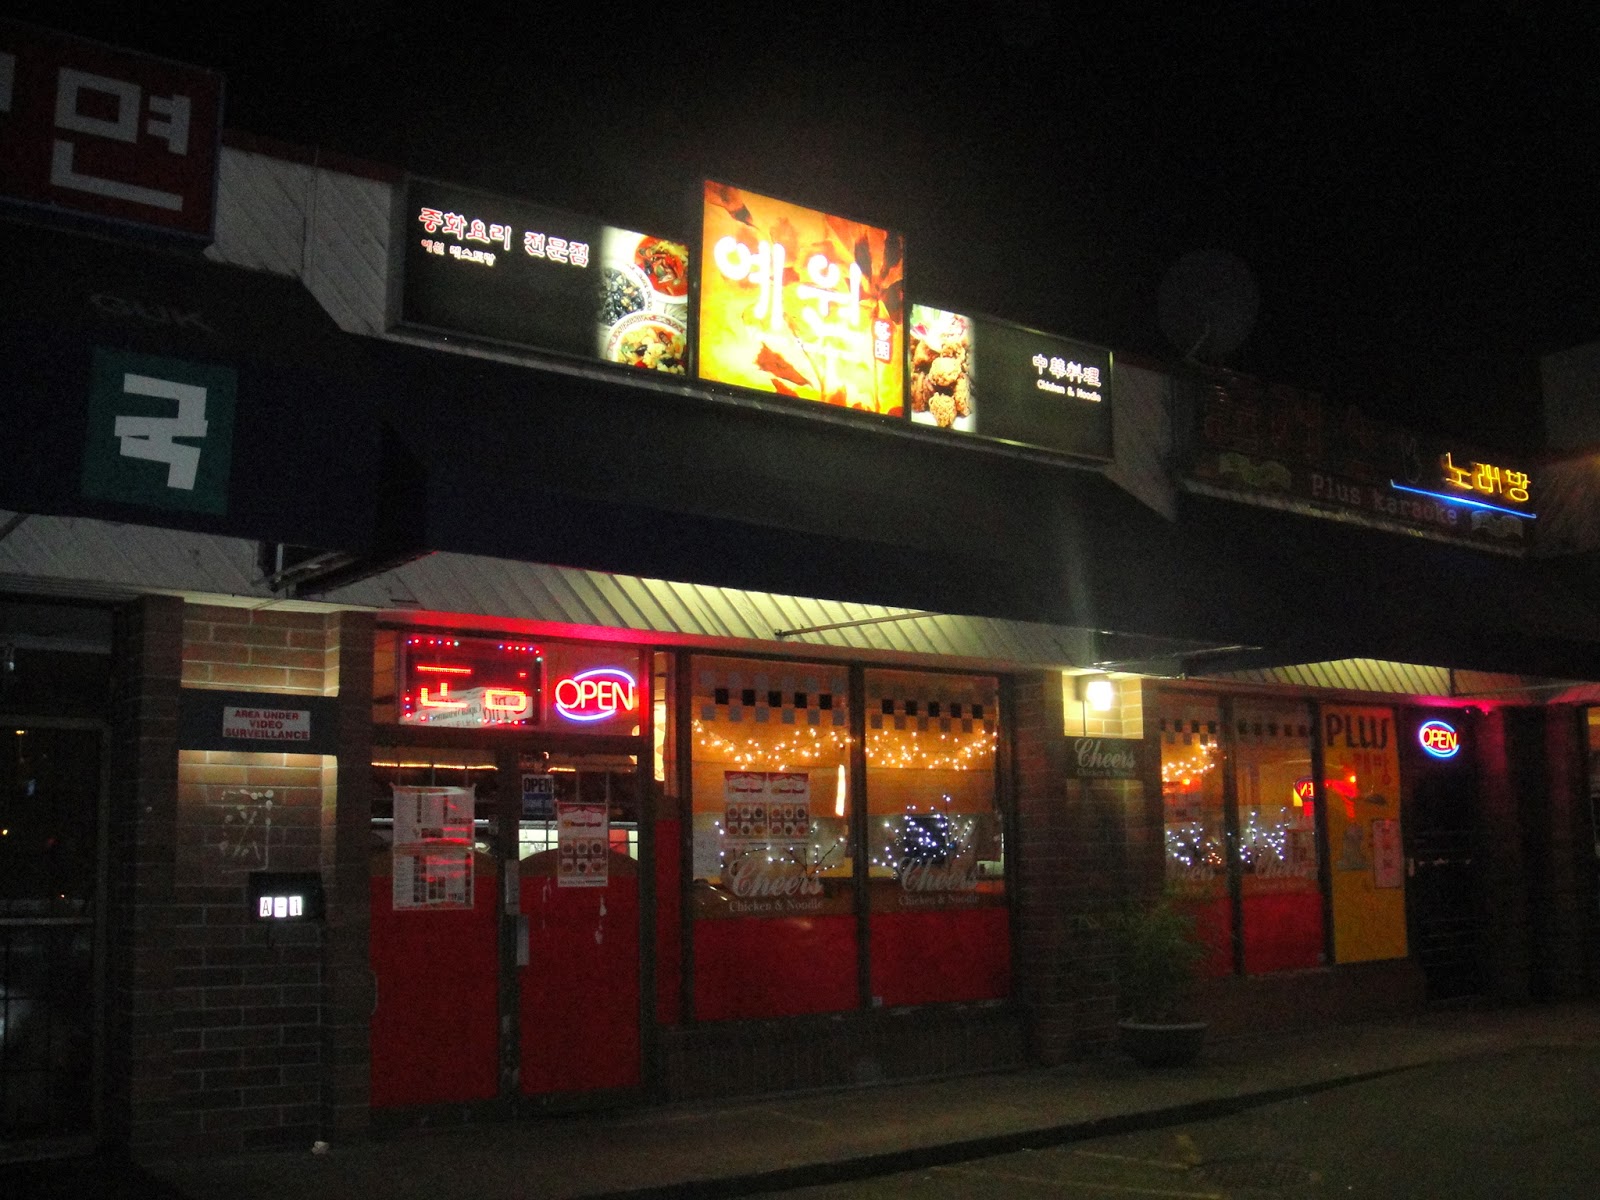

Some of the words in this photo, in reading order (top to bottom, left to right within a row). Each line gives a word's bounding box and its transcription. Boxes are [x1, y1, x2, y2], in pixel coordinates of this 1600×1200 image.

[419, 207, 512, 251] 중화요리
[523, 231, 589, 268] 전문점
[1032, 353, 1102, 388] 中華料理
[1442, 451, 1531, 503] 노래방
[555, 679, 634, 711] OPEN
[234, 709, 260, 719] AREA
[263, 711, 299, 721] UNDER
[249, 719, 283, 730] VIDEO
[225, 728, 309, 740] SURVEILLANCE
[1423, 727, 1457, 750] OPEN
[1074, 738, 1137, 769] Cheers
[523, 777, 553, 793] OPEN
[729, 899, 772, 913] Chicken
[774, 899, 783, 911] &
